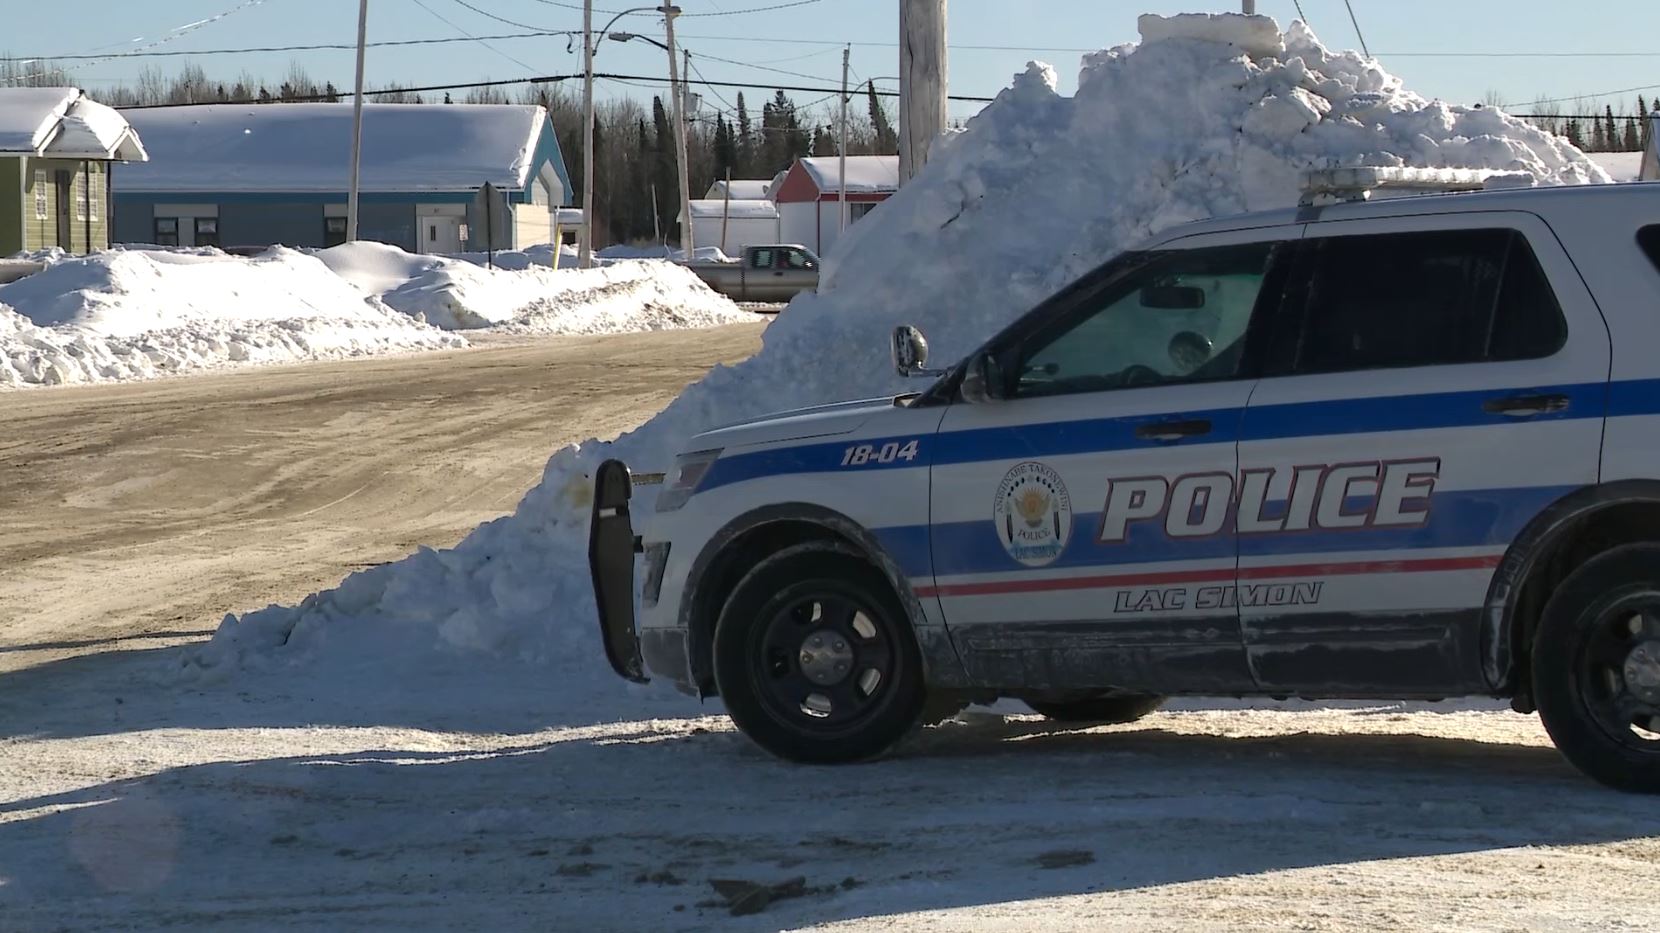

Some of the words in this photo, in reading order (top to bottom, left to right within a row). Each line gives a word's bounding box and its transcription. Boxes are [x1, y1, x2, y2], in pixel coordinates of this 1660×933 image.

[840, 440, 919, 466] 18-04
[1100, 456, 1441, 544] POLICE
[1018, 527, 1051, 541] POLICE
[1113, 588, 1187, 613] LAC
[1195, 582, 1325, 609] SIMON
